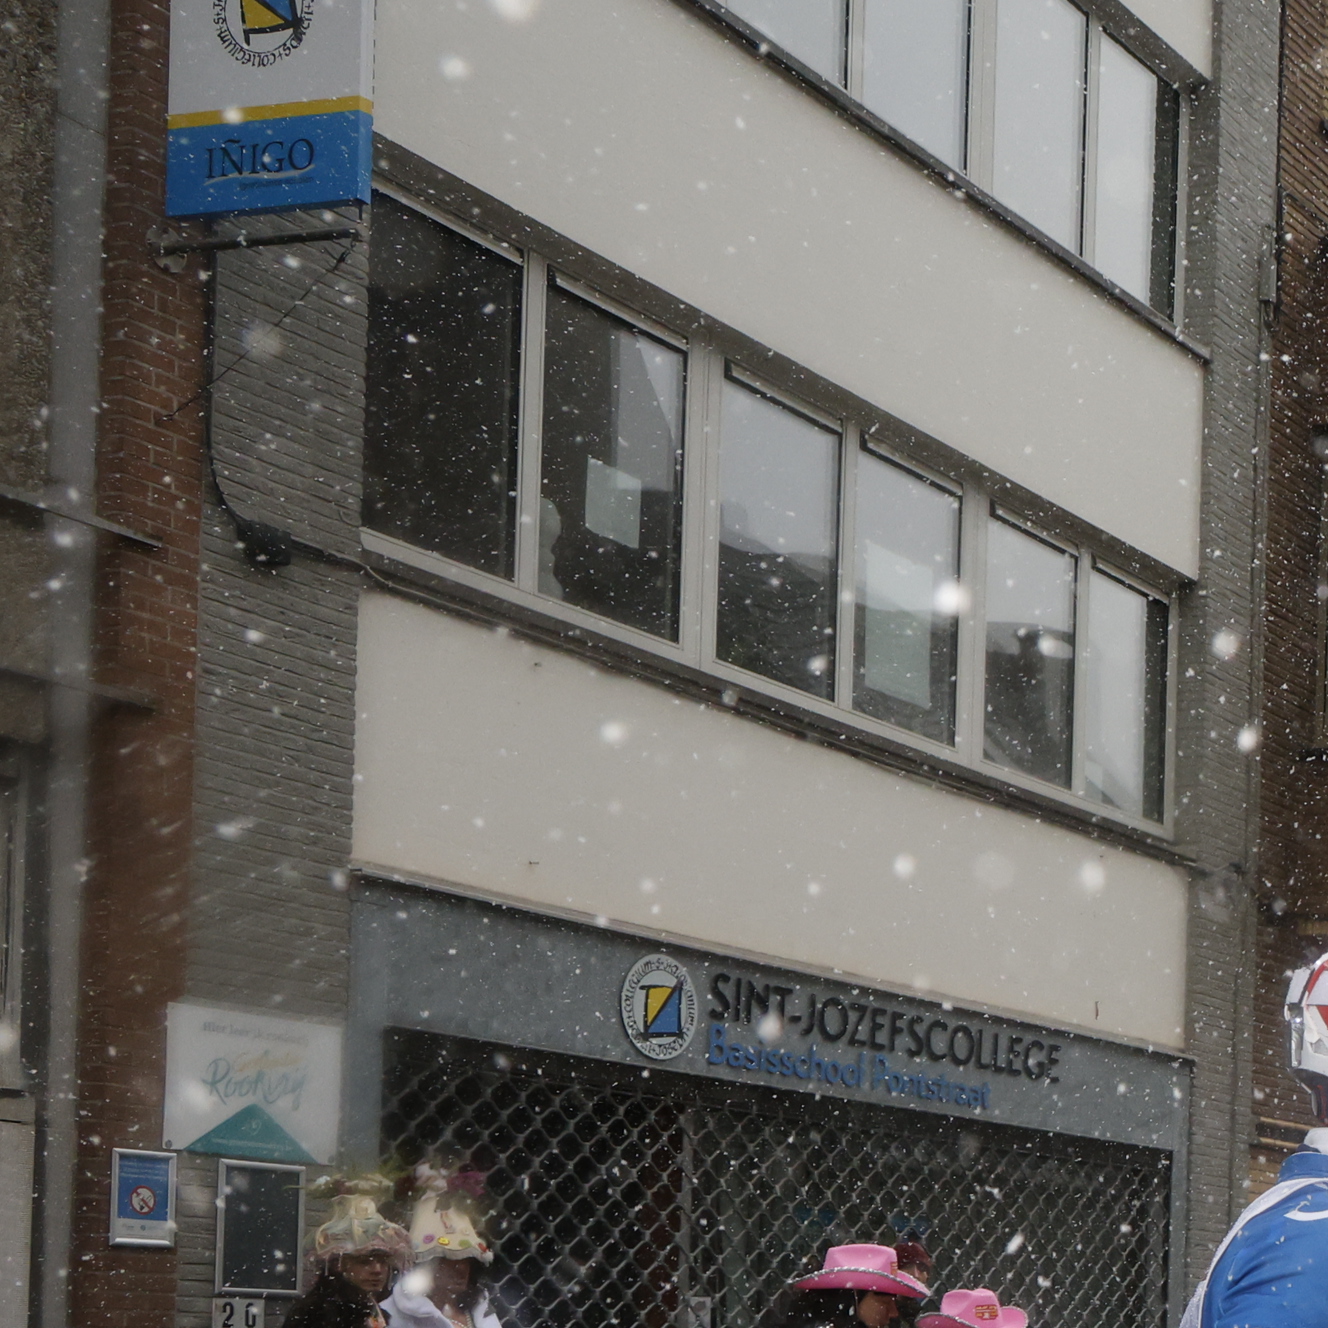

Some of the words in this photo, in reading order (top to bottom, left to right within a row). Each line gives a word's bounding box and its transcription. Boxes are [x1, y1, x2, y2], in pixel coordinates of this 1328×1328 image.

[205, 138, 315, 179] IÑIGO
[707, 1023, 867, 1088] Basisschool
[873, 1053, 992, 1110] Pontstraat
[708, 972, 1063, 1084] SINT-JOZEFSCOLLEGE
